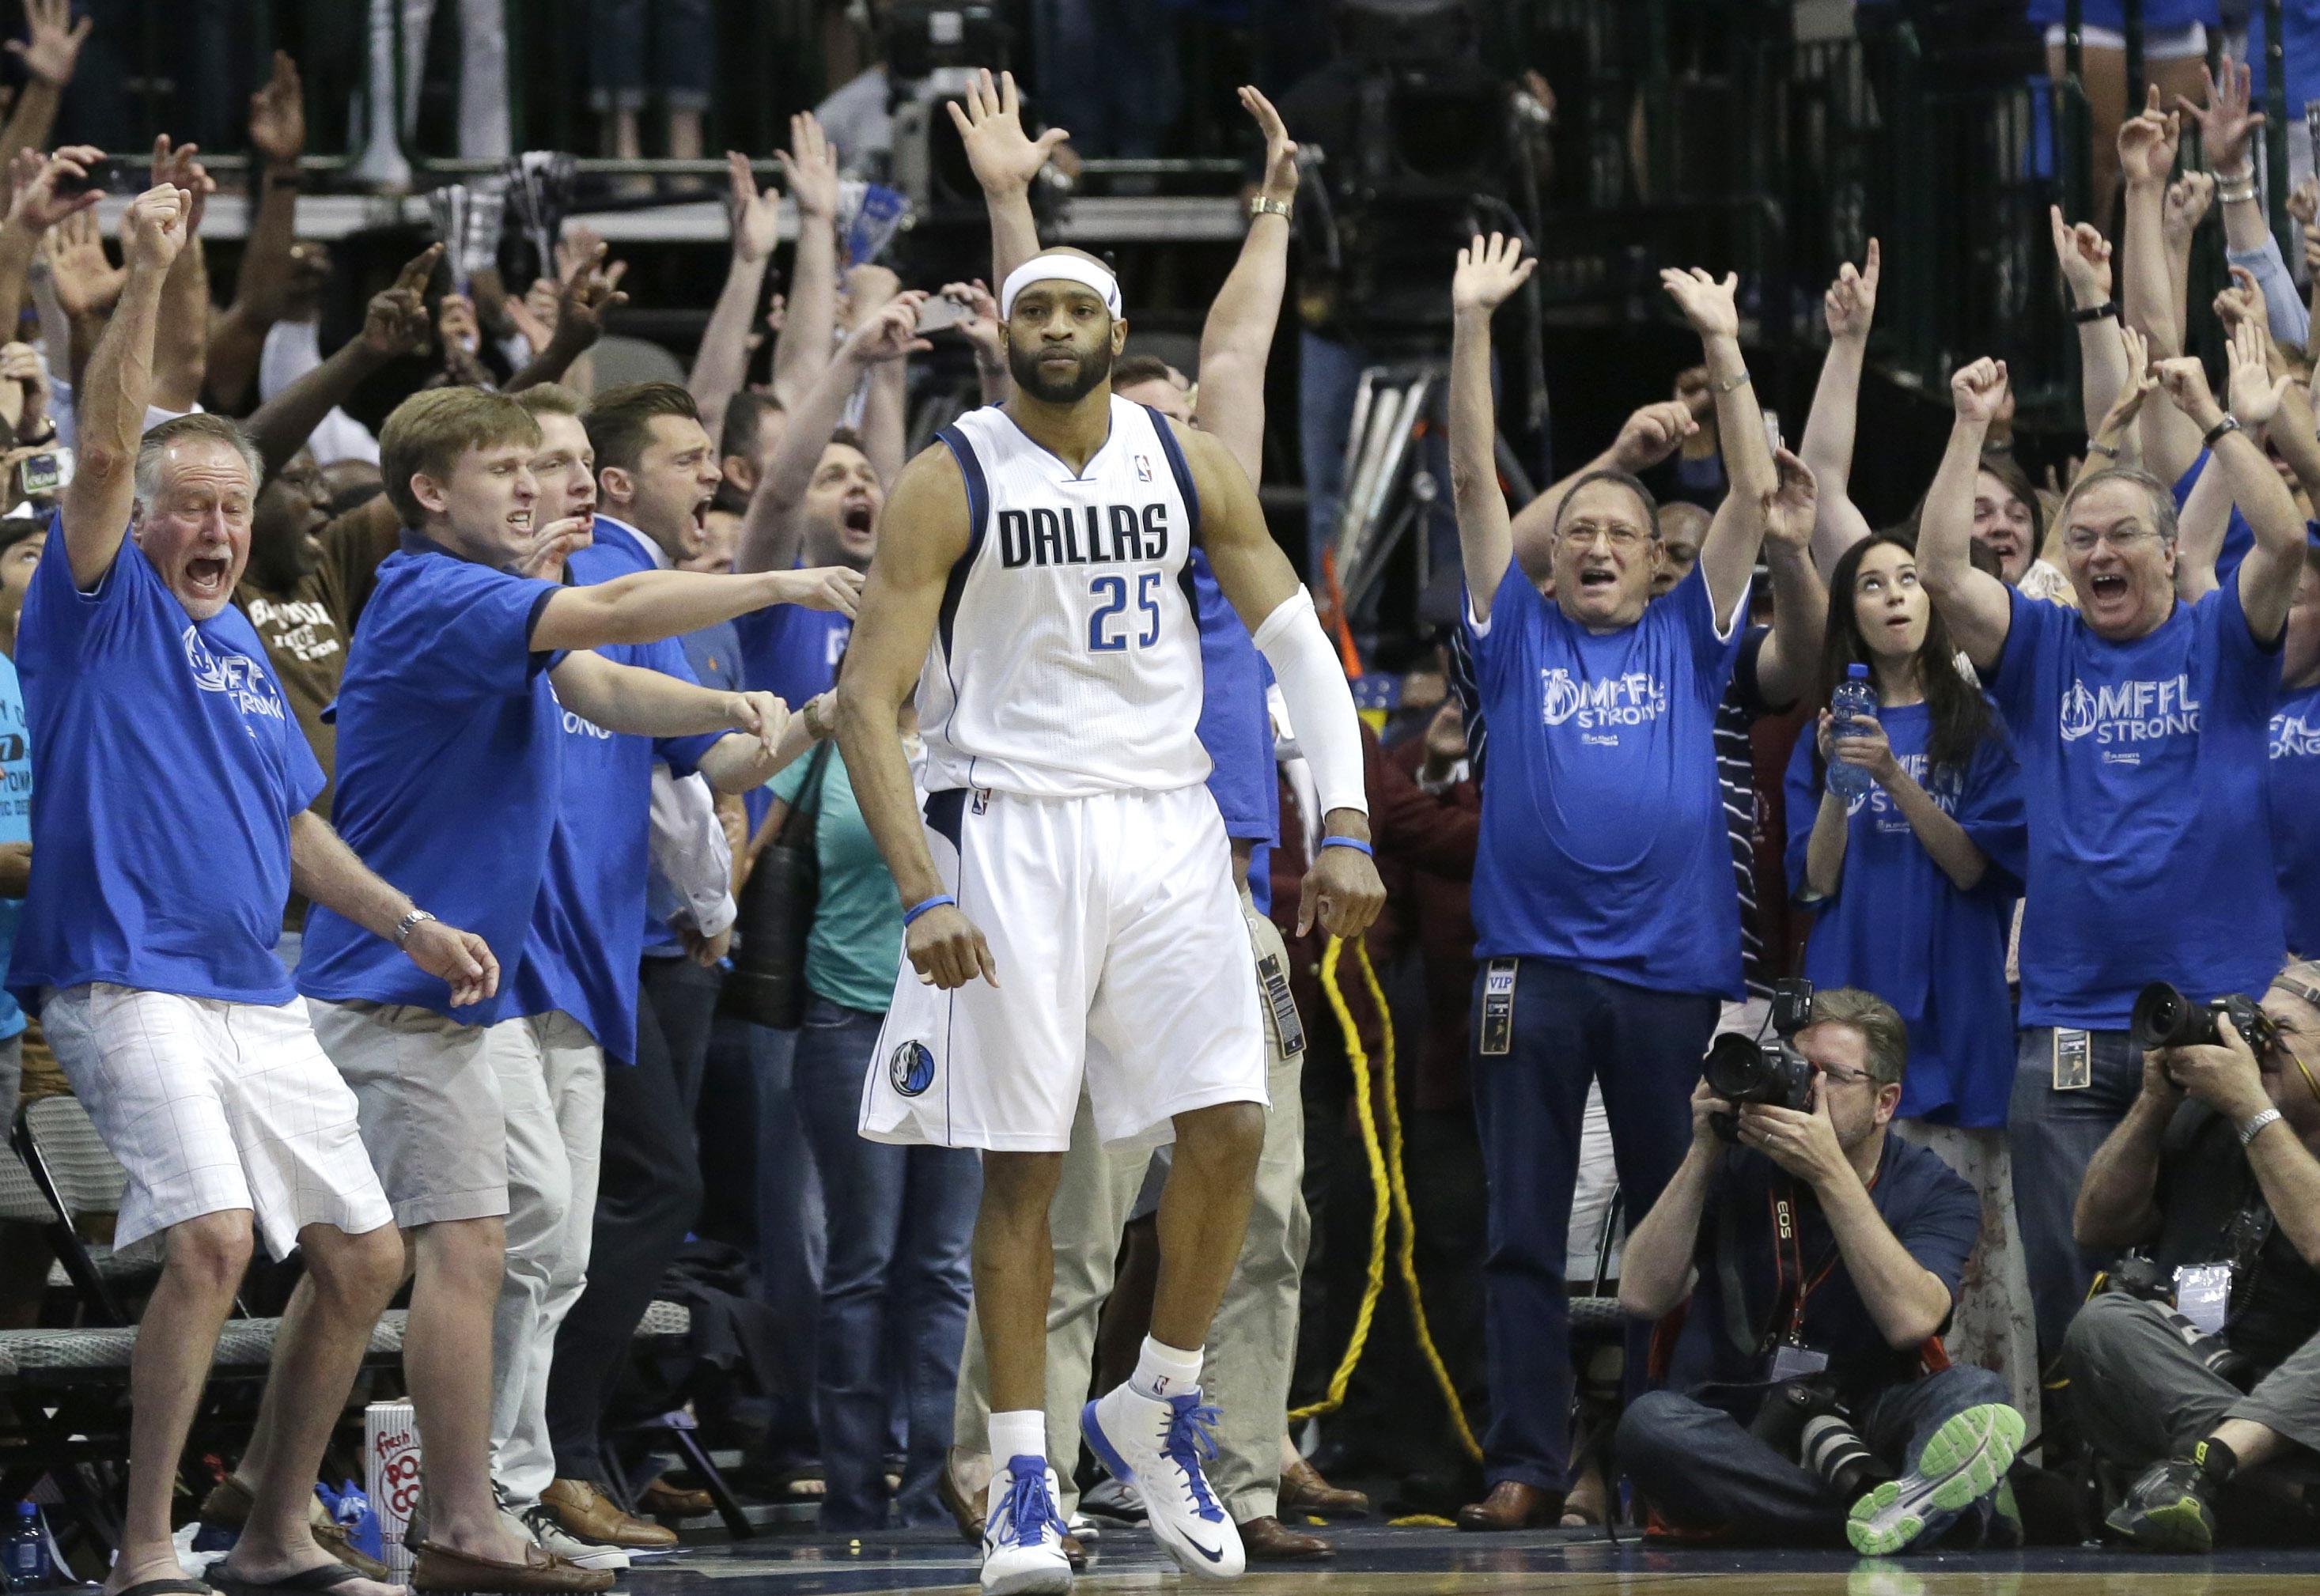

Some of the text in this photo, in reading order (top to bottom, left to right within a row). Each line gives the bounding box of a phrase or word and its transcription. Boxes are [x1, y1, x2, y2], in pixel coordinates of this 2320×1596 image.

[997, 503, 1168, 569] DALLAS
[1088, 570, 1161, 652] 25
[1578, 698, 1666, 728] STRONG
[2098, 674, 2200, 720] MFFL
[1489, 977, 1513, 989] VIP
[1777, 1201, 1792, 1239] EOS
[377, 1428, 411, 1459] fresh
[387, 1455, 418, 1489] PO
